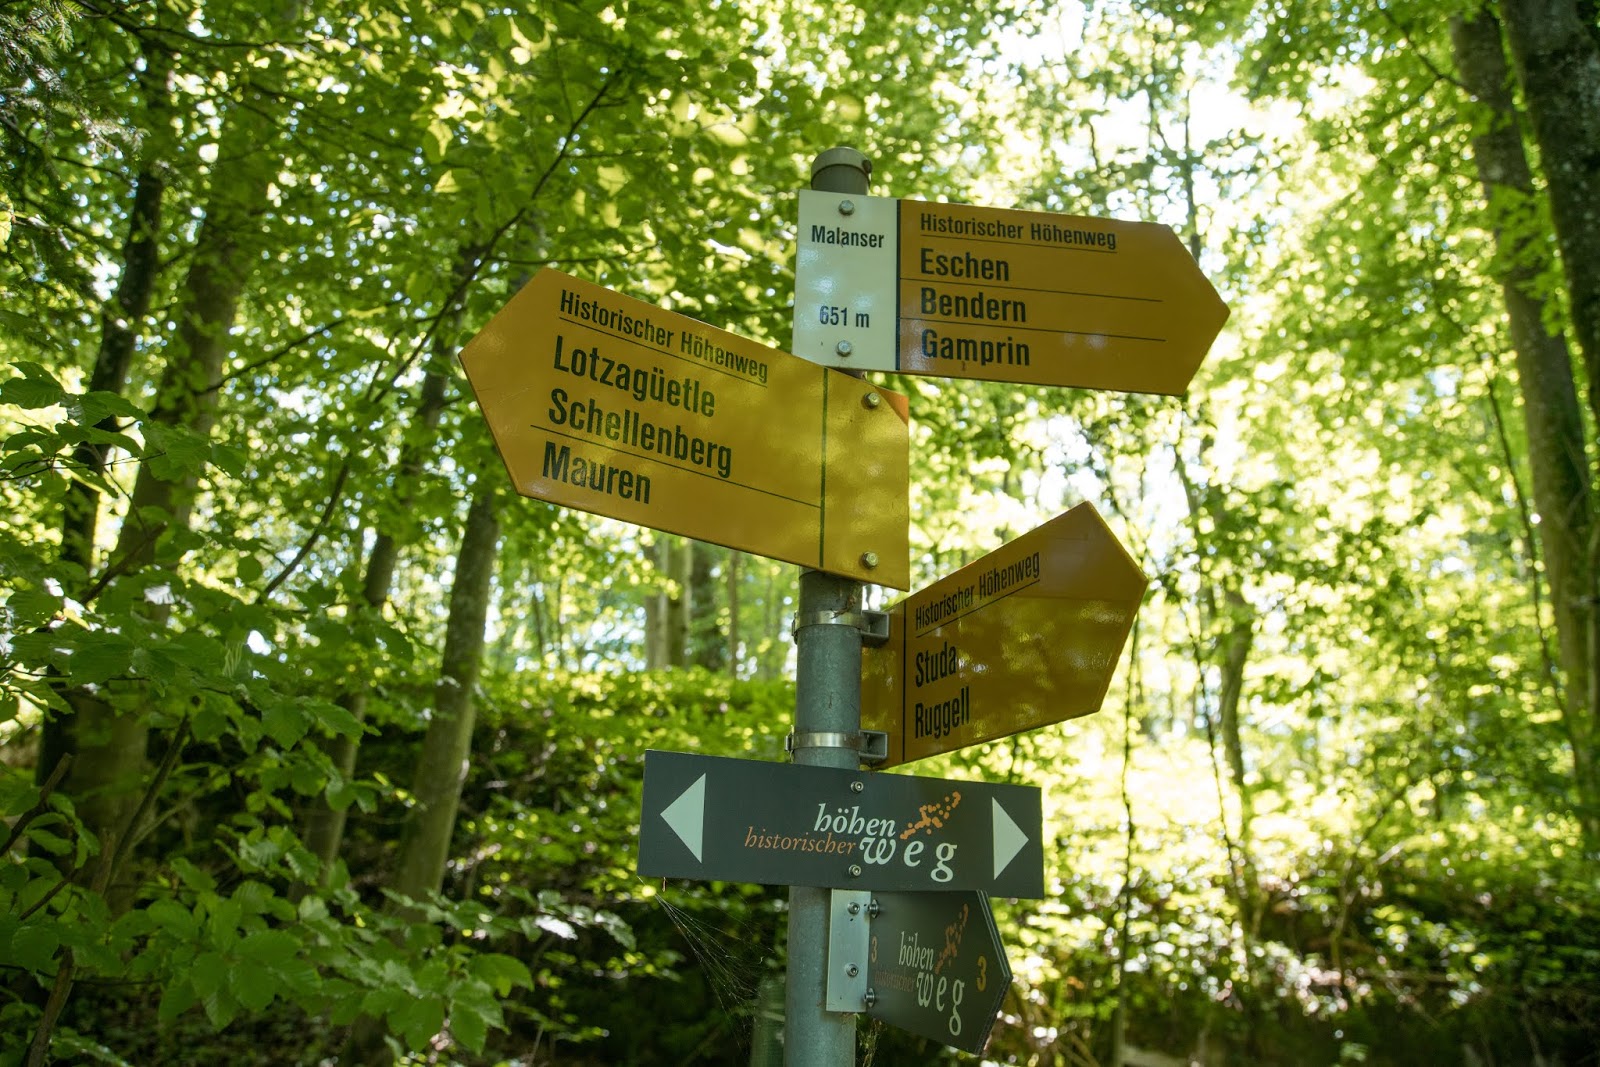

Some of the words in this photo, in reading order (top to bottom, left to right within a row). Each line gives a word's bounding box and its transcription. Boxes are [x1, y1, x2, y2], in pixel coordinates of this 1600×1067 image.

[811, 225, 885, 248] Malanser
[920, 213, 1024, 240] Historischer
[1030, 222, 1117, 250] Höhenweg
[920, 248, 1010, 282] Eschen
[819, 305, 848, 328] 651
[855, 313, 870, 328] m
[920, 287, 1027, 323] Bendern
[560, 289, 674, 347] Historischer
[680, 331, 768, 383] Höhenweg
[921, 329, 1030, 367] Gamprin
[553, 335, 715, 418] Lotzagüetle
[548, 388, 732, 478] Schellenberg
[542, 440, 652, 504] Mauren
[916, 584, 974, 631] Historischer
[979, 552, 1040, 600] Höhenweg
[915, 643, 957, 687] Studa
[915, 686, 970, 739] Ruggell
[813, 803, 897, 838] höhen
[745, 826, 856, 855] historischer
[859, 836, 958, 883] weg
[898, 931, 934, 971] höhen
[976, 955, 988, 992] 3
[916, 971, 965, 1036] weg
